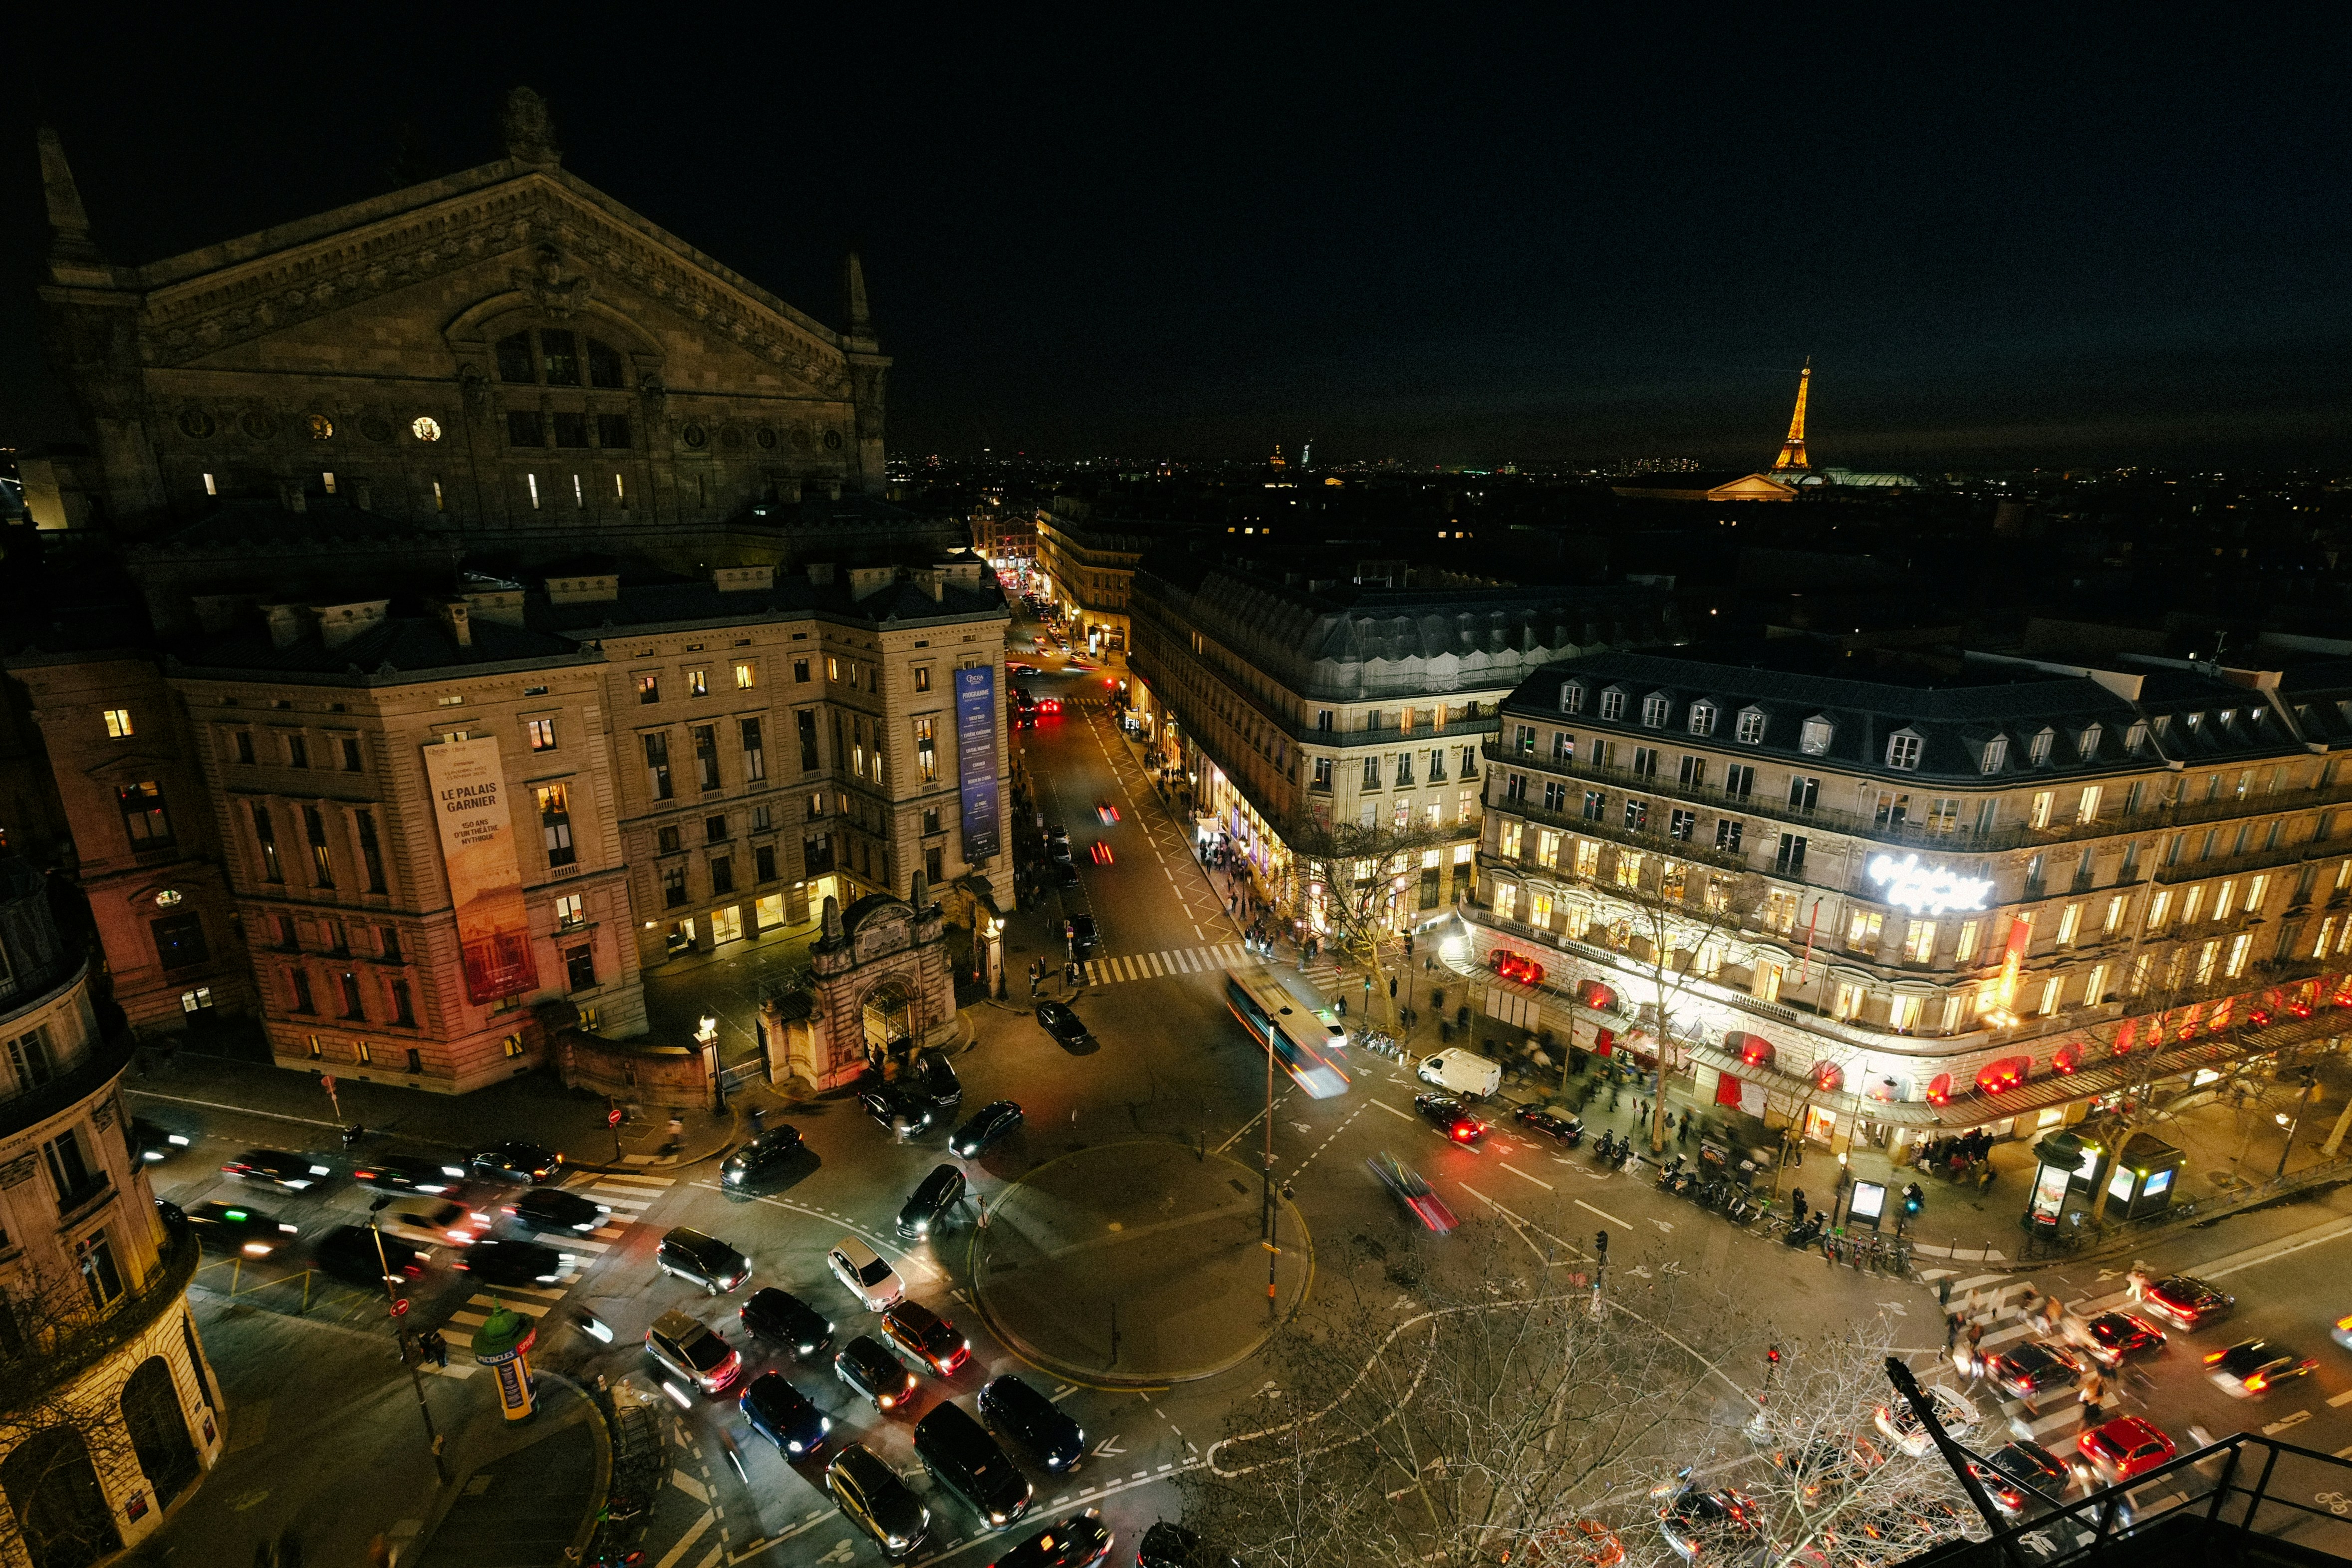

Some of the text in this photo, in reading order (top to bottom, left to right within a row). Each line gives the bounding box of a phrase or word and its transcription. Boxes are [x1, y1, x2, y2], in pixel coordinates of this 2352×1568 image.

[962, 688, 989, 699] PROGRAMME
[441, 783, 497, 801] LE PALAIS
[447, 795, 496, 812] GARNIER
[454, 824, 500, 838] D'UN THÉÂTRE
[462, 833, 495, 845] MYTHIQUE
